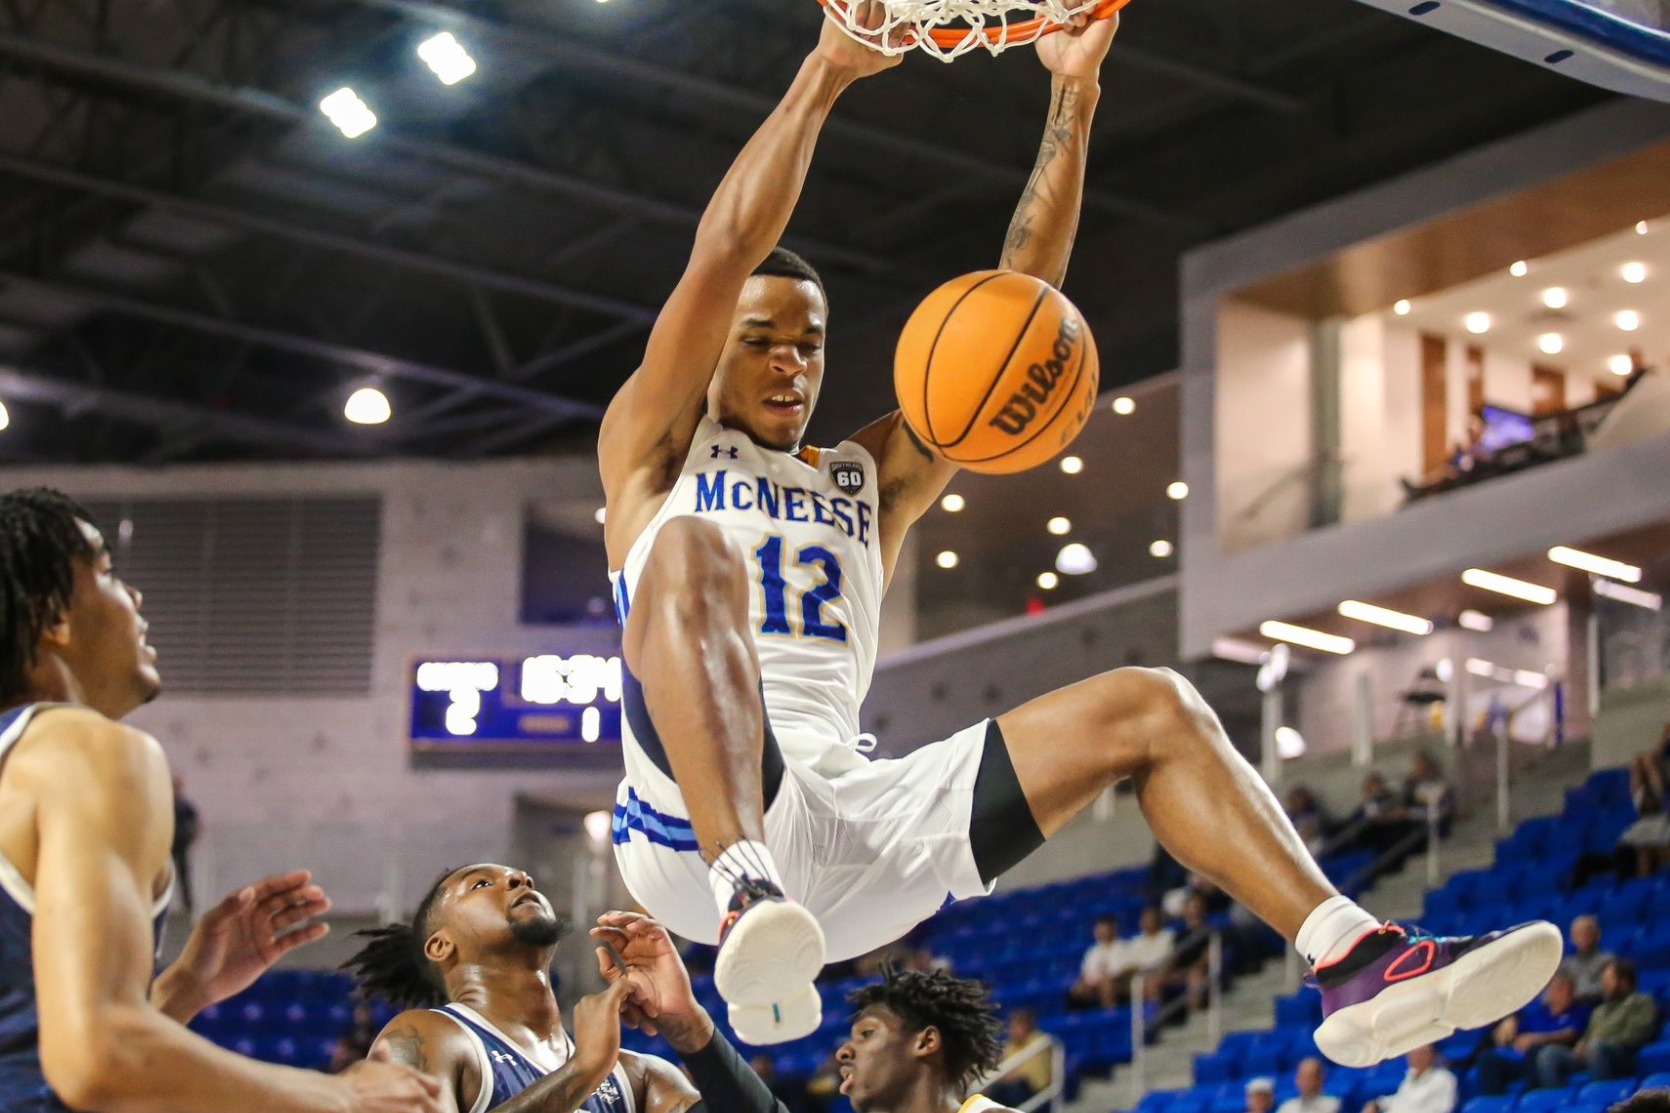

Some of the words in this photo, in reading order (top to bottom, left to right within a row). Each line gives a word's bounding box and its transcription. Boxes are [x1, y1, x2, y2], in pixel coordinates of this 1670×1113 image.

[989, 318, 1079, 436] Wilson
[837, 471, 862, 487] 60
[751, 531, 848, 646] 12
